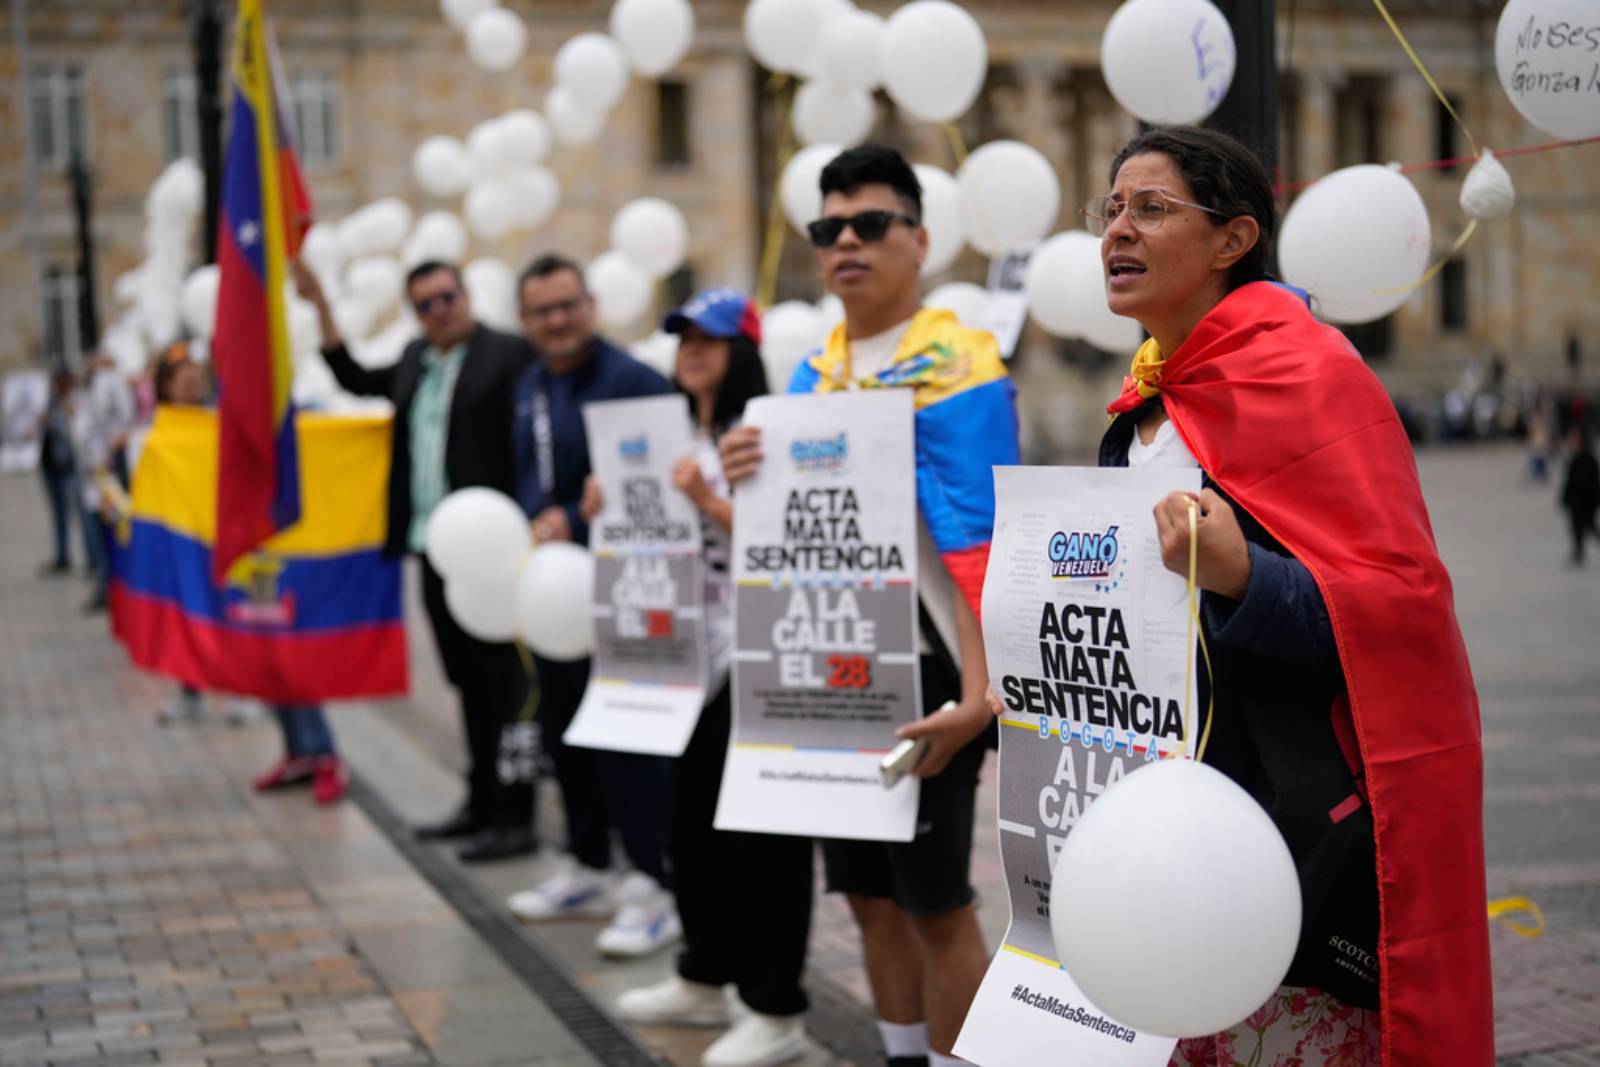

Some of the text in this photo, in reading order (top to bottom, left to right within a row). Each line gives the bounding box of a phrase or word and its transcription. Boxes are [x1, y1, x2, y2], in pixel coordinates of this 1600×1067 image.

[1511, 60, 1600, 95] Gonzal
[785, 488, 859, 514] ACTA
[784, 517, 861, 541] MATA
[1049, 526, 1119, 566] GANÓ
[746, 545, 904, 572] SENTENCIA
[1051, 559, 1109, 577] VENEZUELA
[786, 588, 860, 620] A LA
[772, 619, 876, 651] CALLE
[1039, 602, 1130, 649] ACTA
[780, 653, 870, 688] EL 28
[1040, 642, 1136, 690] MATA
[1002, 675, 1184, 741] SENTENCIA
[1053, 746, 1077, 790] A
[1011, 984, 1136, 1043] #ActaMataSentencia
